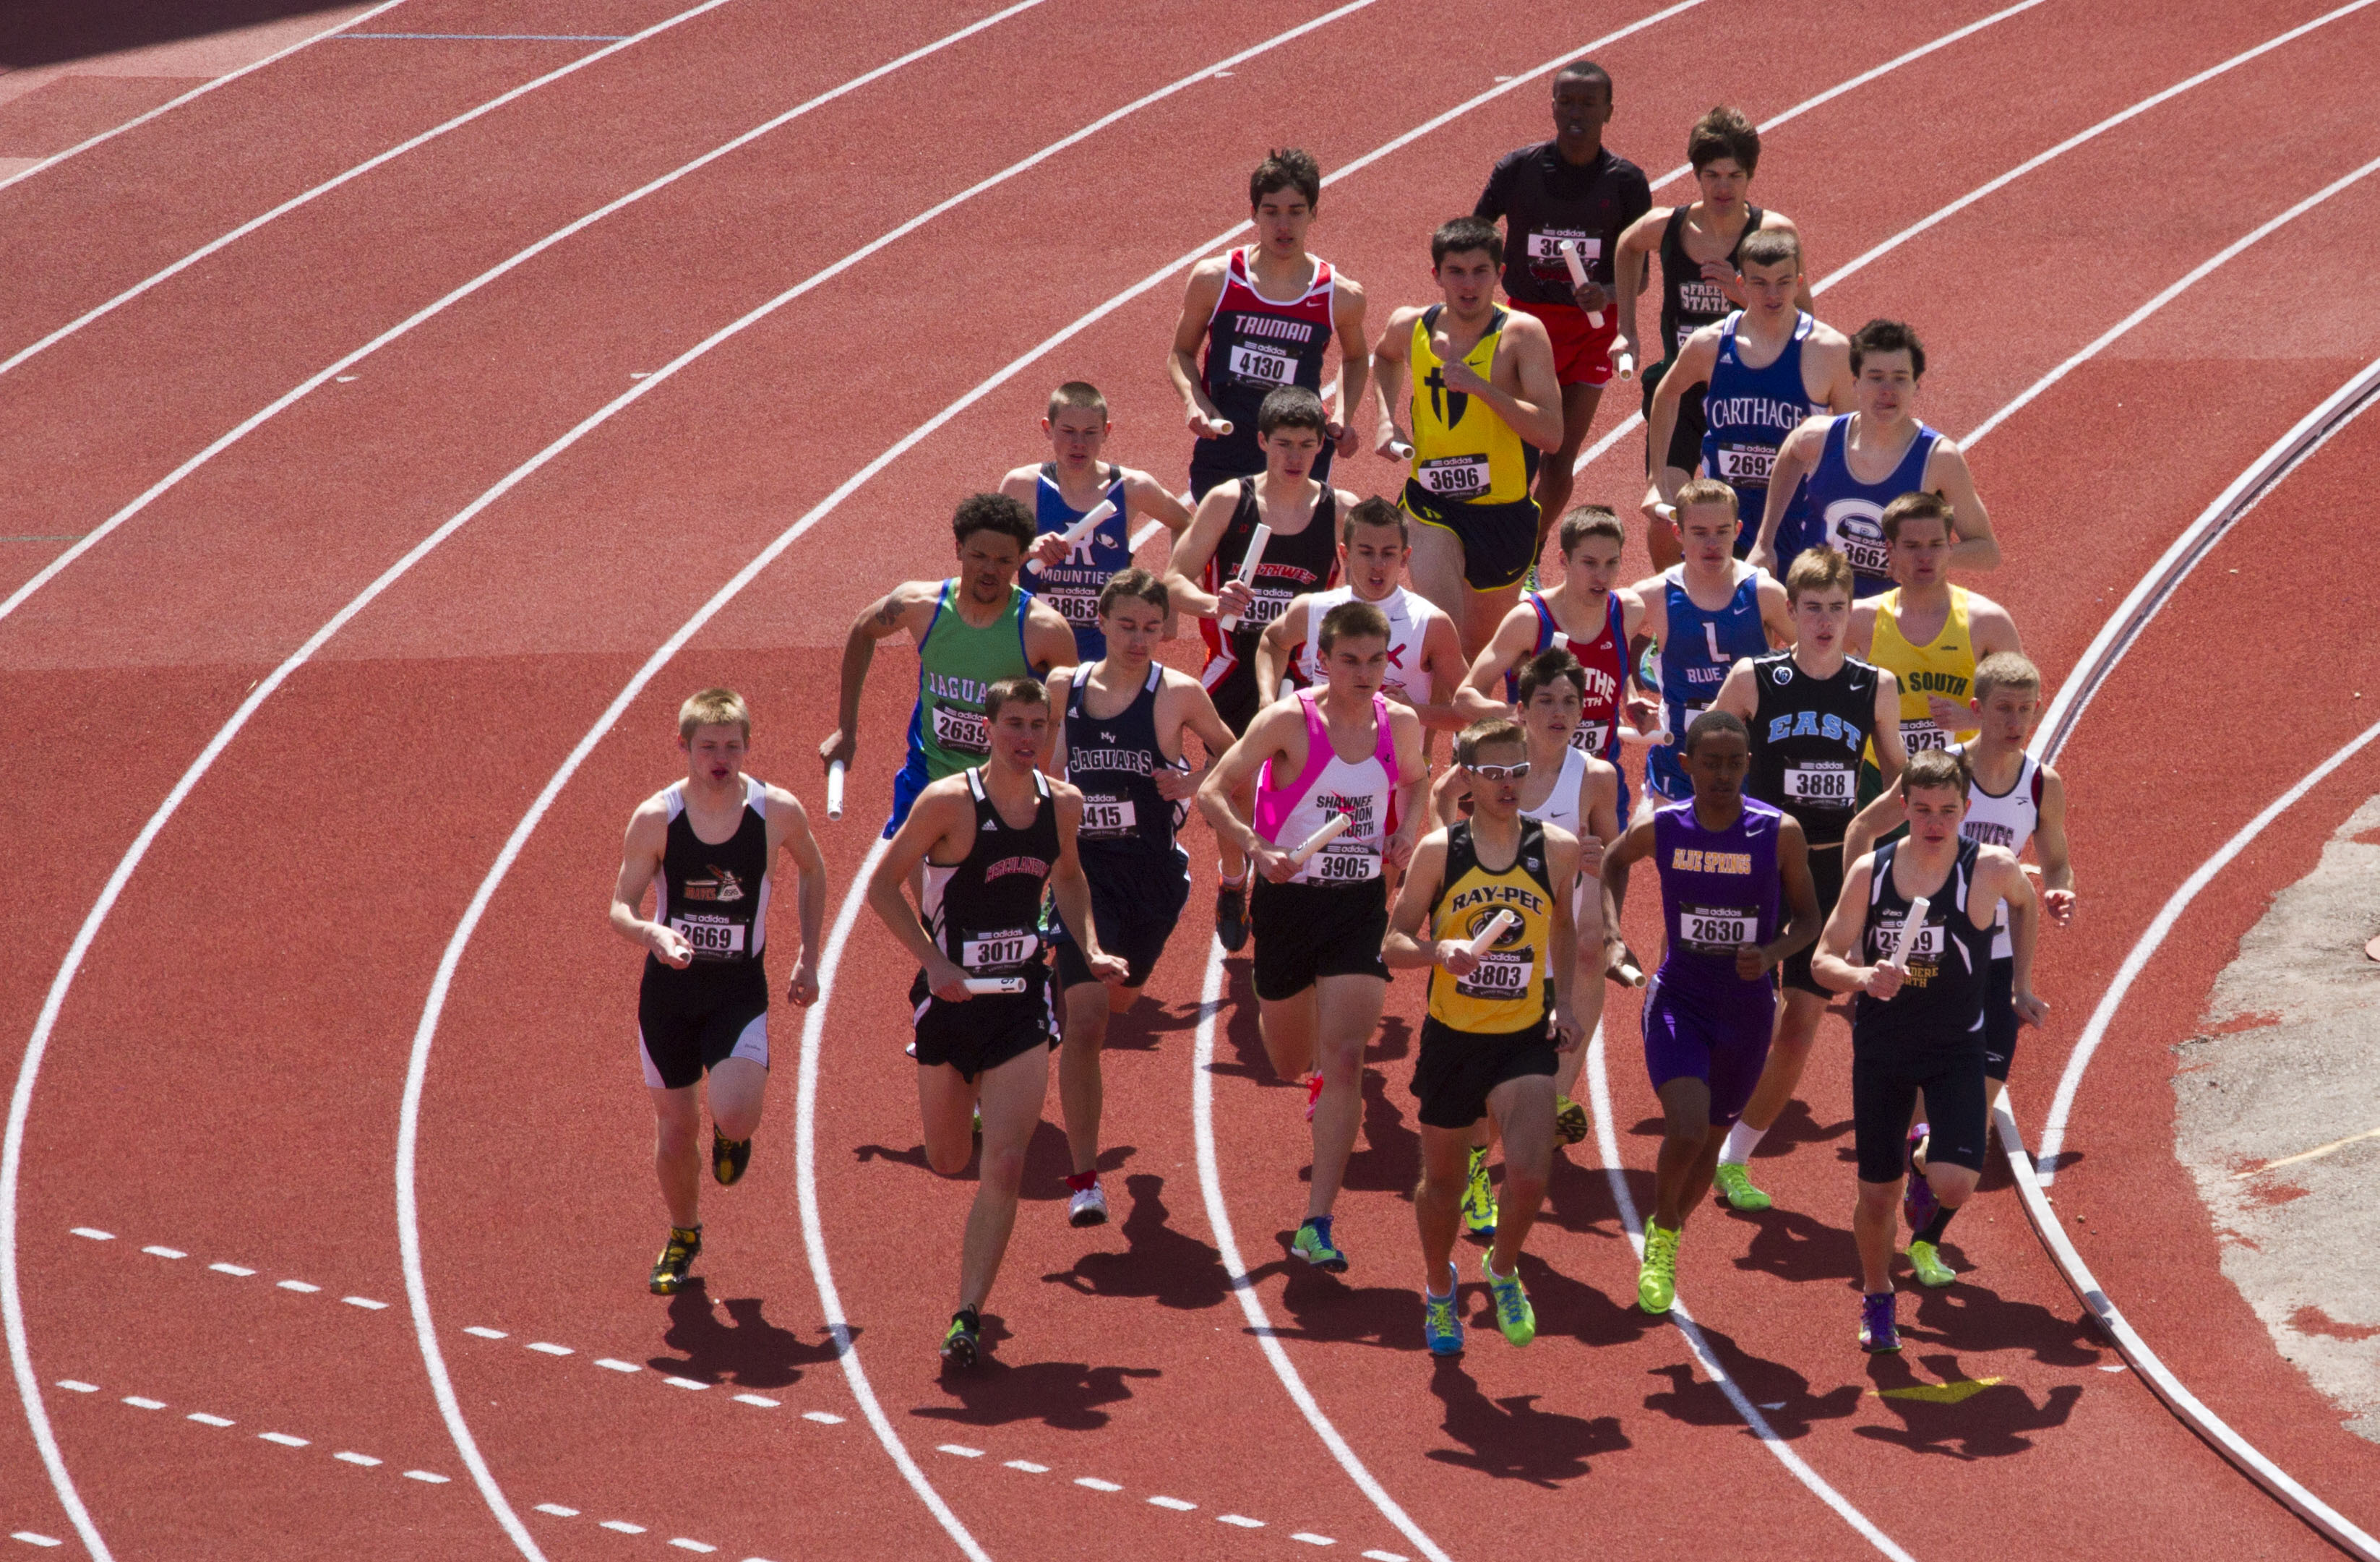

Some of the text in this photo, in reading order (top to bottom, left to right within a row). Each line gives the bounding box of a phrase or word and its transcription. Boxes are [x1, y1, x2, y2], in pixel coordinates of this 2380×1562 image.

[1556, 229, 1586, 239] adidas
[1680, 283, 1730, 311] STATE
[1690, 284, 1721, 297] FREE
[1234, 315, 1313, 343] TRUMAN
[1258, 344, 1286, 356] adidas
[1240, 353, 1284, 379] 4130
[1443, 456, 1473, 467] adidas
[1429, 468, 1479, 491] 3696
[1065, 587, 1096, 596] adidas
[1263, 588, 1294, 598] adidas
[1702, 622, 1730, 663] L
[1686, 667, 1722, 684] BLUE
[1909, 671, 1967, 696] SOUTH
[939, 717, 987, 743] 2639
[1768, 711, 1862, 752] EAST
[1902, 731, 1946, 755] 925
[1070, 747, 1152, 777] JAGUARS
[1816, 762, 1844, 771] adidas
[1796, 773, 1845, 796] 3888
[1087, 794, 1117, 803] adidas
[1316, 795, 1373, 809] SHAWNEE
[1341, 846, 1370, 855] adidas
[1320, 857, 1370, 879] 3905
[1672, 849, 1752, 875] BLUE SPRINGS
[1451, 885, 1544, 915] RAY-PEC
[698, 914, 730, 924] adidas
[1710, 909, 1743, 918] adidas
[681, 924, 731, 949] 2669
[993, 930, 1023, 939] adidas
[1692, 918, 1744, 943] 2630
[978, 940, 1024, 964] 3017
[1490, 952, 1521, 962] adidas
[1469, 965, 1521, 987] 3803
